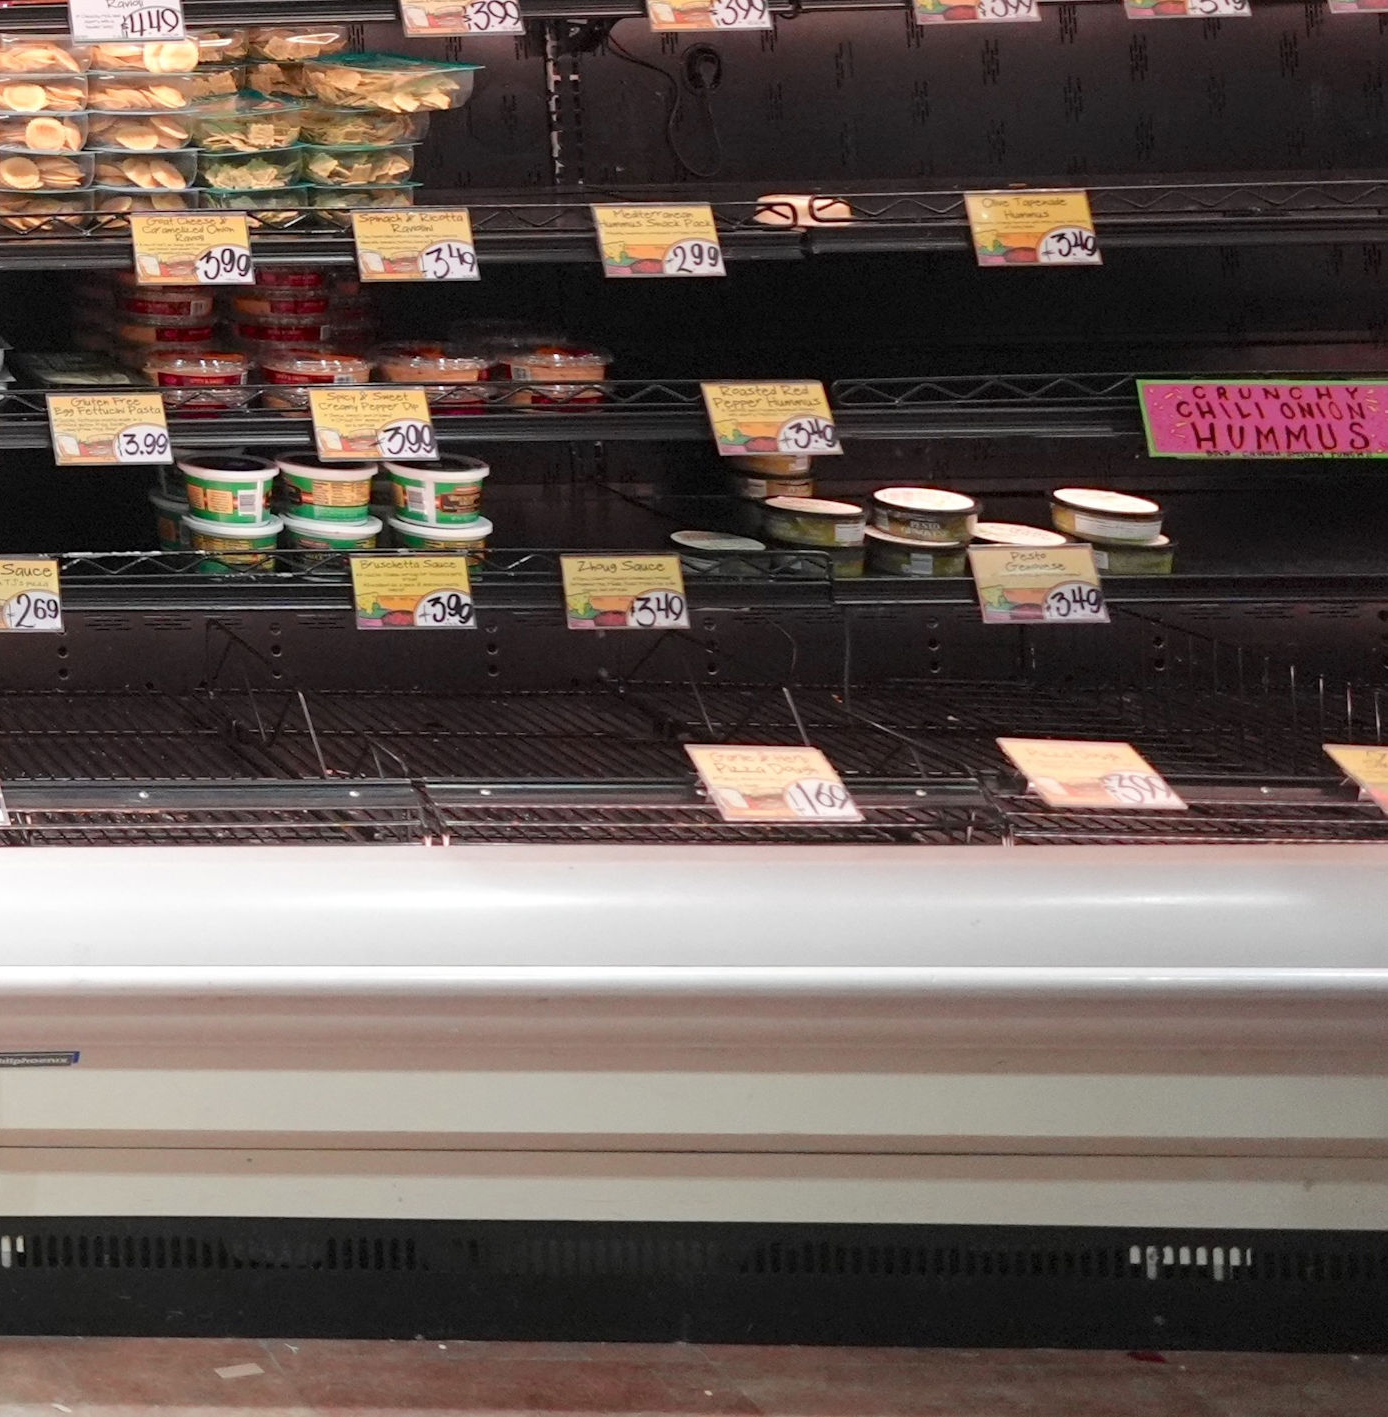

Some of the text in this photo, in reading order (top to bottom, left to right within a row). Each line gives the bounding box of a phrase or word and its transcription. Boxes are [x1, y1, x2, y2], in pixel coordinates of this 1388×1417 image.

[175, 216, 217, 225] Cheese
[358, 213, 403, 224] Spinach
[419, 212, 465, 223] Ricotta
[206, 224, 235, 235] Onion
[720, 384, 810, 397] Roasted Red
[1191, 385, 1359, 401] CRUNCHY
[69, 396, 141, 407] Gluten Free
[326, 391, 358, 408] Spicy
[372, 390, 408, 402] Sweet
[713, 396, 823, 413] Pepper Hummus
[53, 406, 76, 417] Egg
[127, 405, 162, 415] Pasta
[317, 401, 420, 418] Creamy Pepper Dip
[1175, 400, 1367, 421] CHILI ONION
[1190, 421, 1371, 451] HUMMUS
[1010, 550, 1047, 563] Pesto
[0, 563, 53, 578] Sauce
[360, 559, 458, 570] Bruschetta Sauce
[620, 560, 666, 573] Sauce
